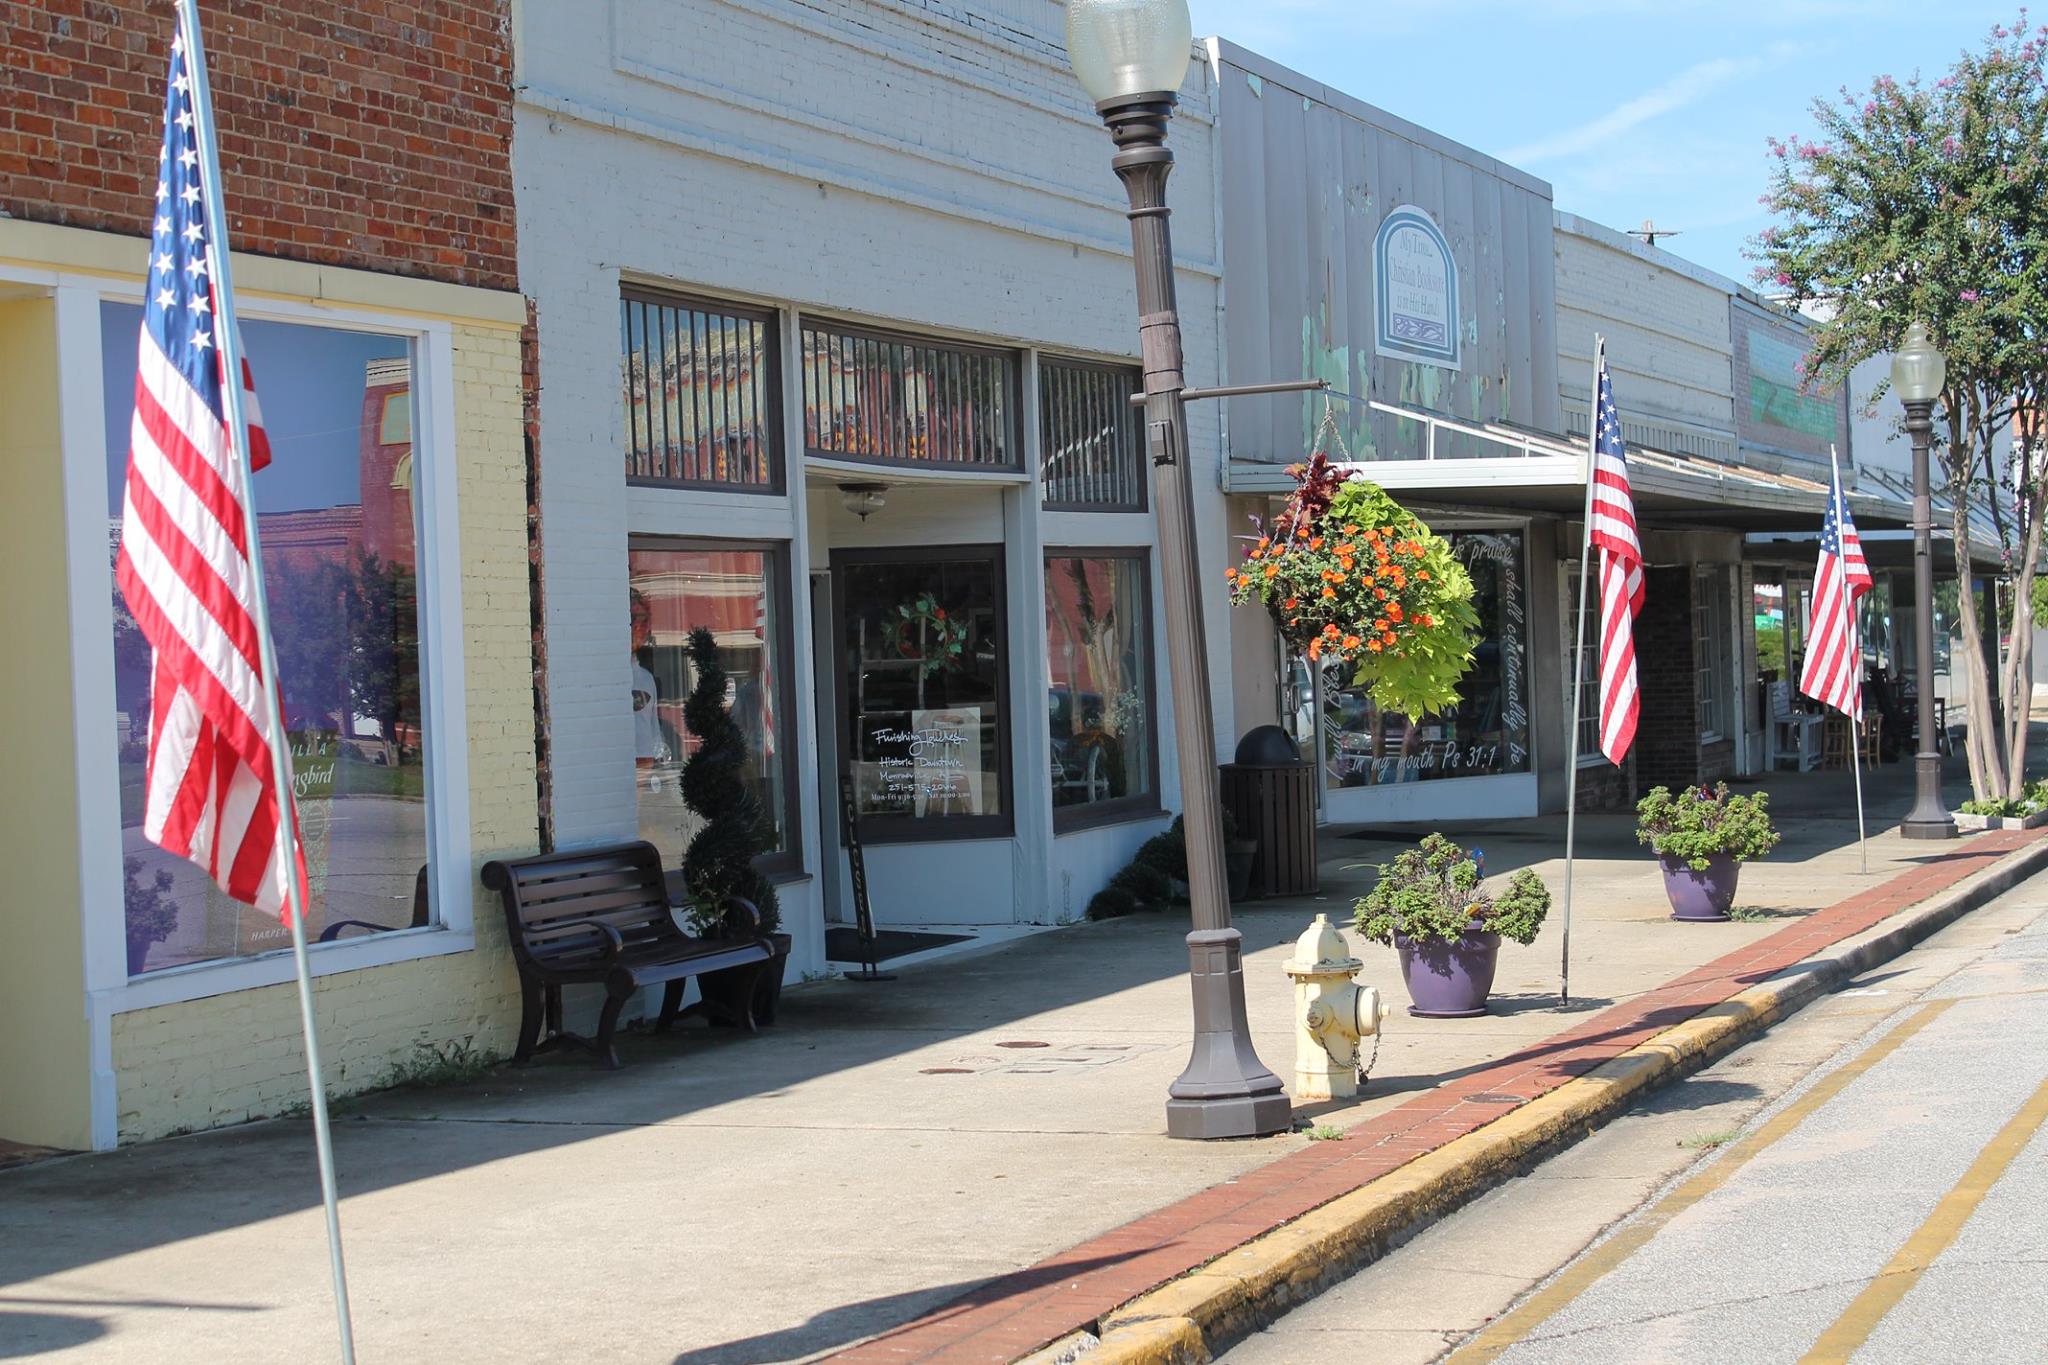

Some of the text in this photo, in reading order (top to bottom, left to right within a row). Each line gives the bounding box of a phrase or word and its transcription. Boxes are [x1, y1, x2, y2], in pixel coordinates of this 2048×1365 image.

[1390, 256, 1416, 287] Christian
[1468, 540, 1513, 572] praise
[1502, 568, 1527, 765] shall continually be
[319, 742, 327, 755] A
[872, 728, 969, 756] Finishing Touches
[879, 756, 914, 767] Historic
[1351, 751, 1362, 773] in
[1371, 757, 1390, 781] my
[1397, 743, 1434, 770] mouth
[1442, 741, 1461, 769] Ps
[251, 927, 288, 941] HARPER
